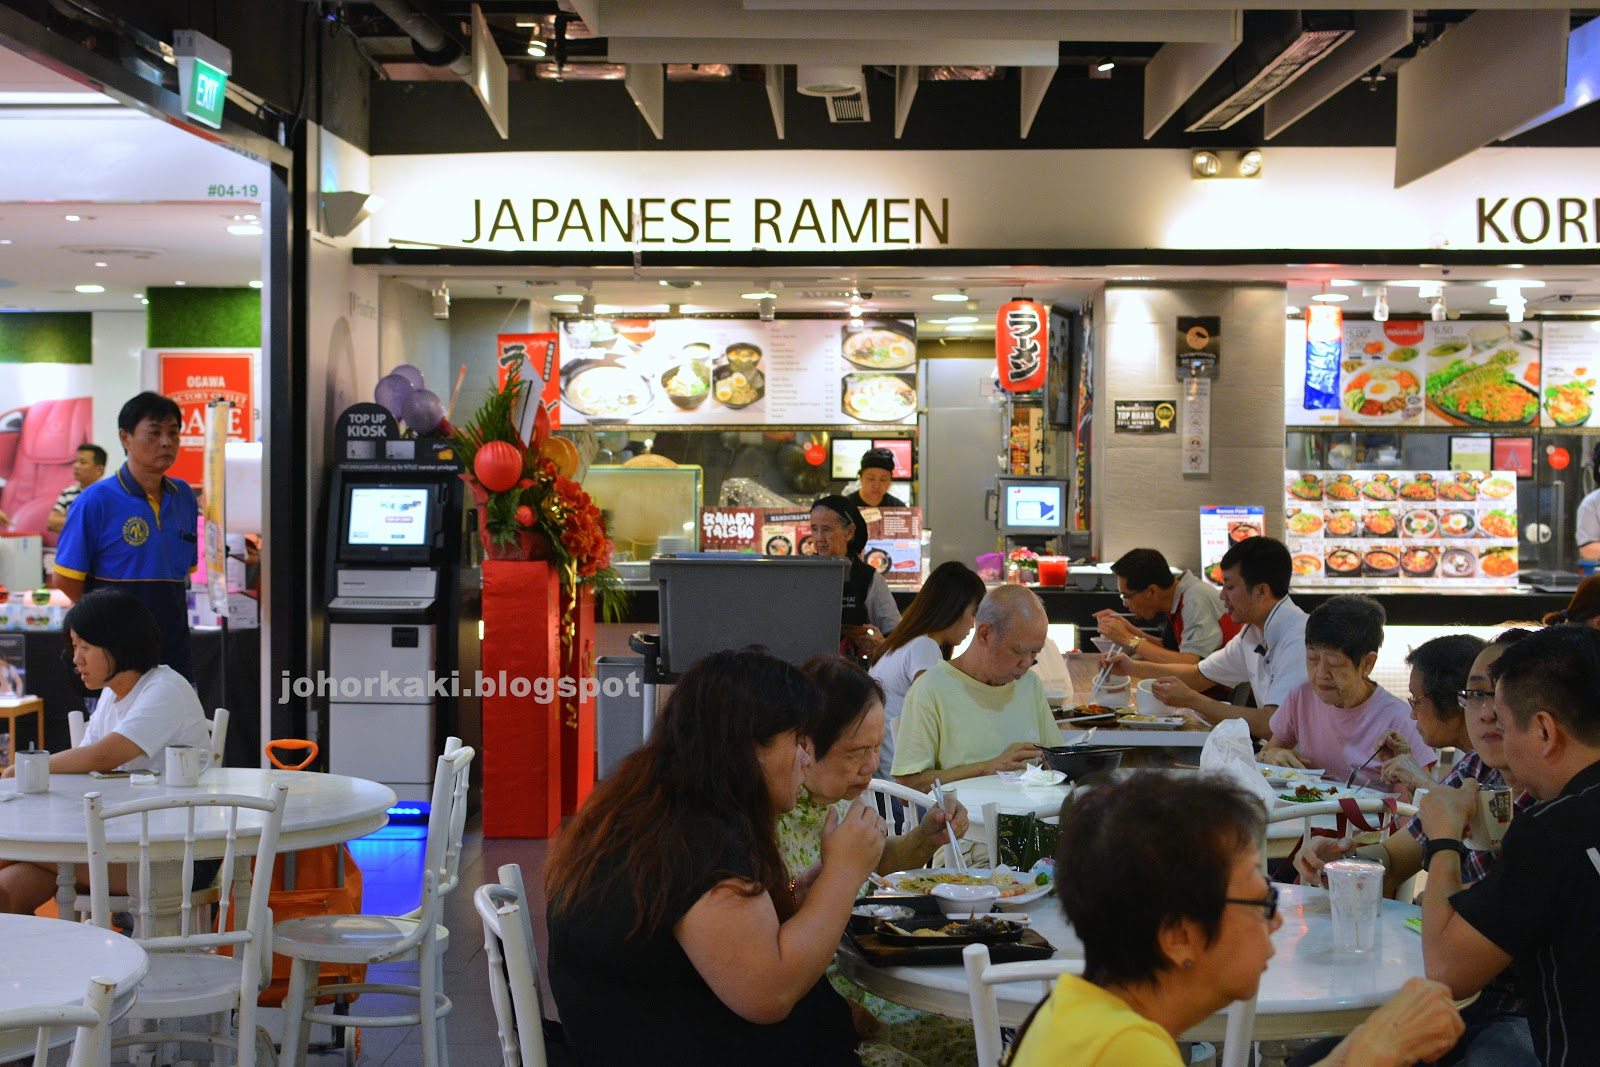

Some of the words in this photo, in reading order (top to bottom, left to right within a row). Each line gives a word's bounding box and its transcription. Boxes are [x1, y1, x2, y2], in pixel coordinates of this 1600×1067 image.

[196, 74, 219, 112] EXIT
[208, 185, 258, 197] #04-19
[462, 198, 731, 244] JAPANESE
[753, 198, 949, 244] RAMEN
[186, 375, 226, 388] OGAWA
[349, 414, 369, 424] TOP
[371, 414, 386, 424] UP
[1117, 412, 1130, 420] TOP
[1131, 412, 1154, 420] BRAND
[347, 425, 387, 437] KIOSK
[703, 512, 754, 526] RAMEN
[703, 524, 755, 539] TAISHO
